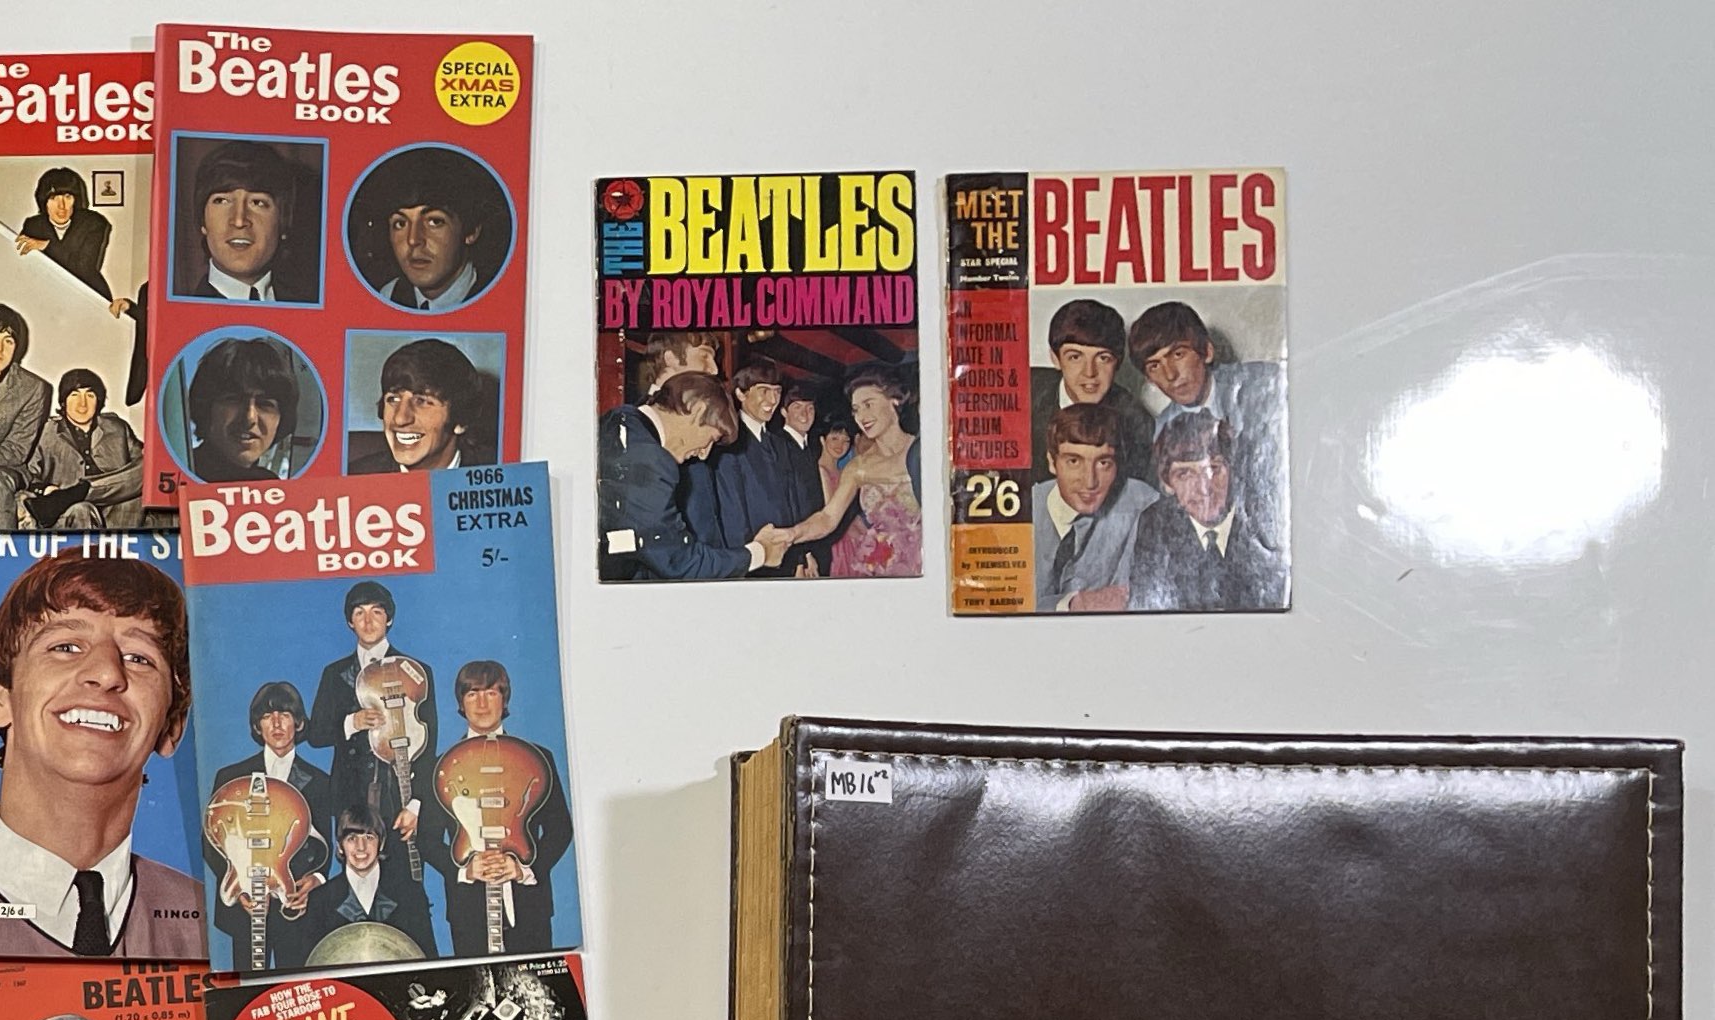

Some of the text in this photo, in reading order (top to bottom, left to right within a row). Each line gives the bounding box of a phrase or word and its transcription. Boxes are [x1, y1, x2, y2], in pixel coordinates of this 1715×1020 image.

[179, 31, 399, 124] The Beatles BOOK
[443, 60, 513, 77] SPECIAL
[441, 77, 514, 92] XMAS
[450, 93, 506, 108] EXTRA
[957, 190, 1023, 221] MEET
[648, 176, 914, 276] BEATLES
[971, 220, 1020, 251] THE
[1035, 173, 1277, 286] BEATLES
[602, 275, 913, 330] BY ROYAL COMMAND
[466, 468, 503, 486] 1966
[448, 486, 534, 511] CHRISTMAS
[188, 486, 426, 572] The Beatles BOOK
[457, 511, 528, 533] EXTRA
[153, 908, 200, 920] RINGO
